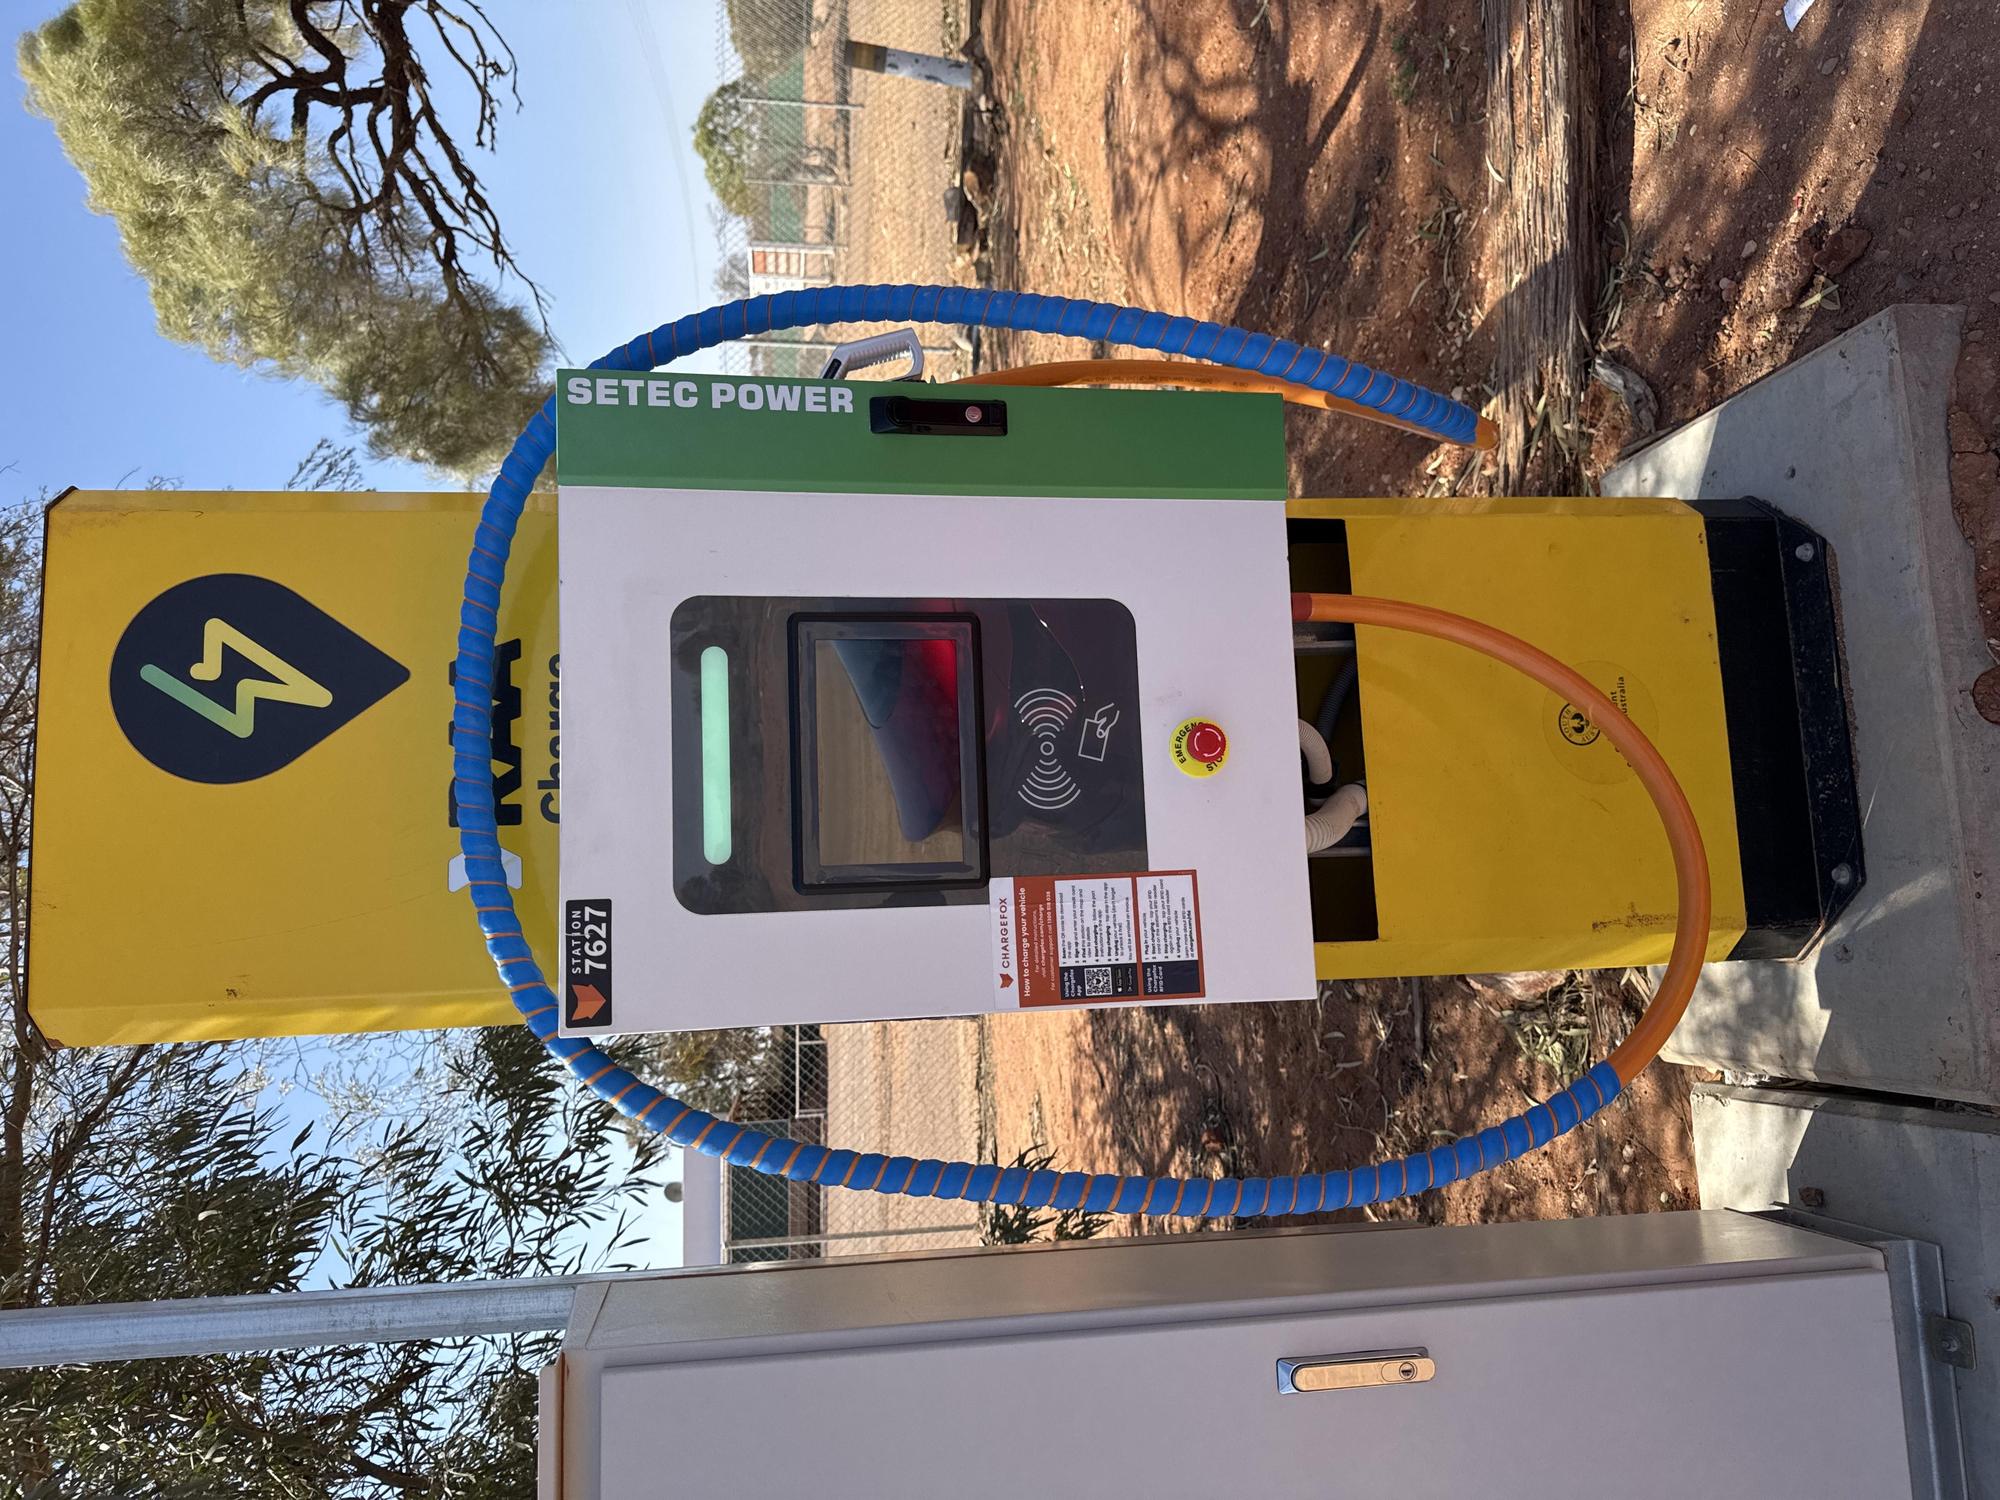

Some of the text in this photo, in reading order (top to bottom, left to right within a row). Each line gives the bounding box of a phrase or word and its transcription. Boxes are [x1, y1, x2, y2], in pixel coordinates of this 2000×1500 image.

[567, 378, 853, 414] SETEC POWER
[1617, 676, 1628, 716] ustralia
[572, 910, 582, 974] STATION
[584, 906, 607, 974] 7627
[999, 898, 1010, 968] CHARGEFOX
[1020, 918, 1029, 936] your
[1020, 938, 1030, 967] charge
